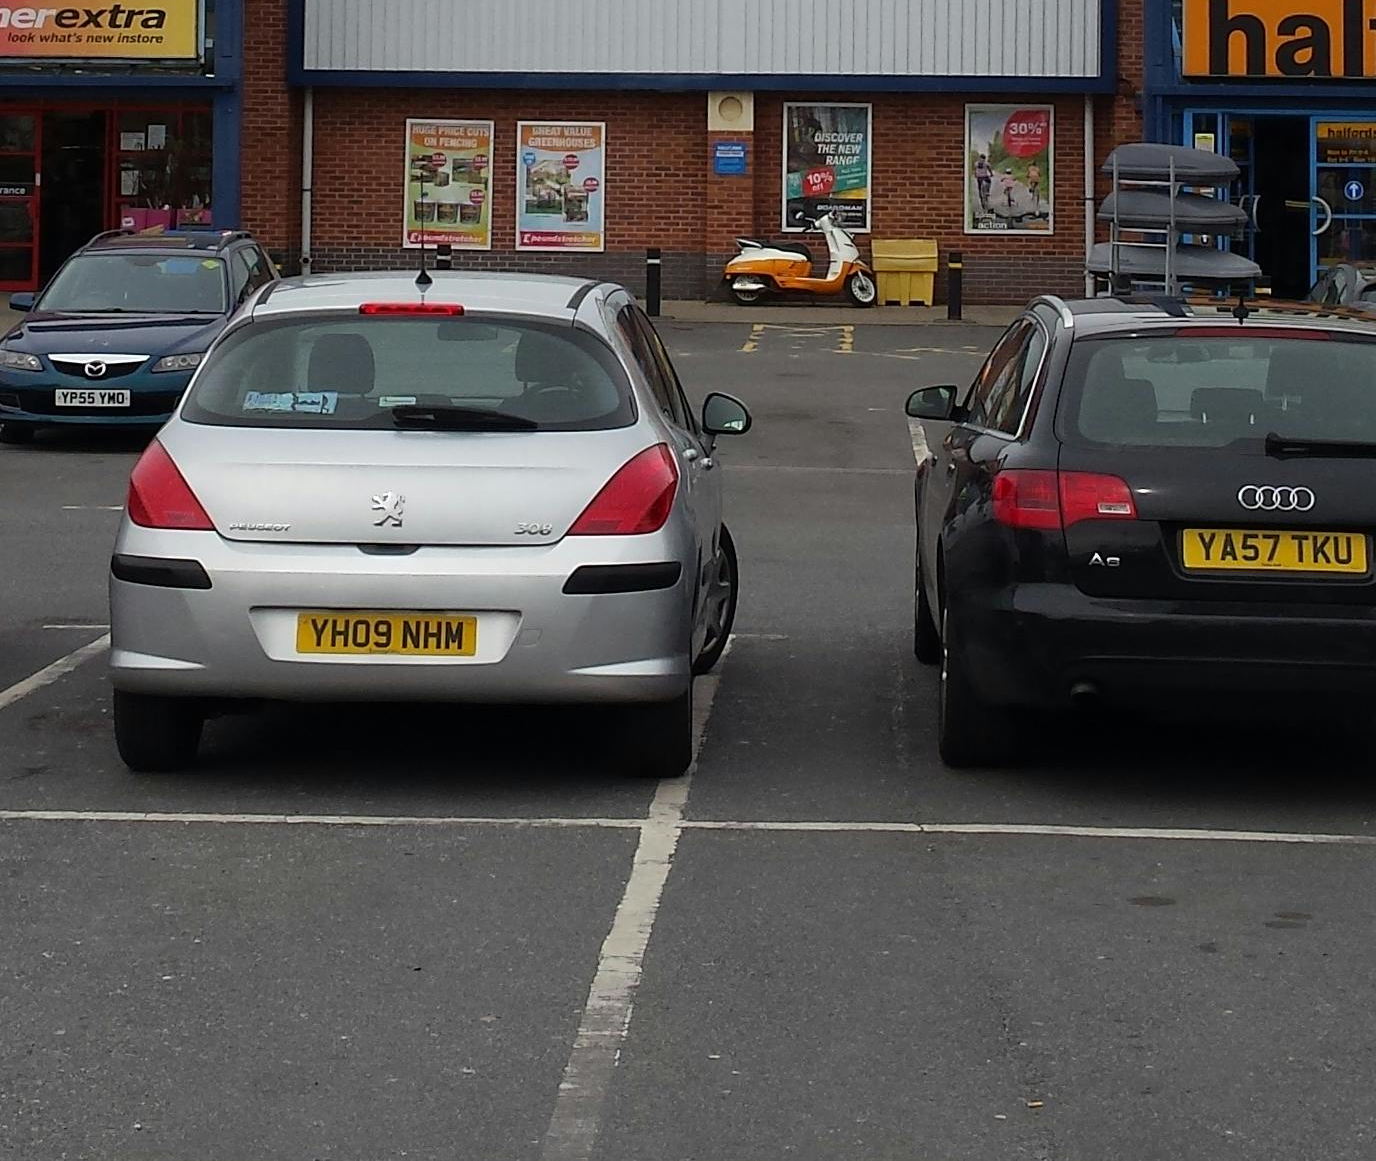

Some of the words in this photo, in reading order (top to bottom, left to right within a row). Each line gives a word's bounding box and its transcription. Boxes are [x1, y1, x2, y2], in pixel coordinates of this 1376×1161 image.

[7, 32, 35, 43] look
[39, 32, 83, 44] what's
[86, 34, 113, 44] new
[117, 33, 164, 44] instore
[412, 125, 437, 134] HUGE
[438, 126, 465, 136] PRICE
[467, 127, 490, 136] CUTS
[532, 126, 561, 136] GREAT
[563, 127, 593, 136] VALUE
[424, 137, 437, 146] ON
[528, 137, 596, 148] GREENHOUSES
[814, 132, 864, 143] DISCOVER
[817, 144, 836, 154] THE
[837, 144, 862, 154] NEW
[62, 392, 95, 404] YP55
[229, 522, 291, 532] PEUGEOT
[514, 522, 553, 536] 308
[1198, 532, 1282, 563] YA57
[1286, 534, 1353, 565] TKU
[1088, 552, 1120, 567] A6
[311, 618, 391, 649] YH09
[402, 620, 464, 650] NHM
